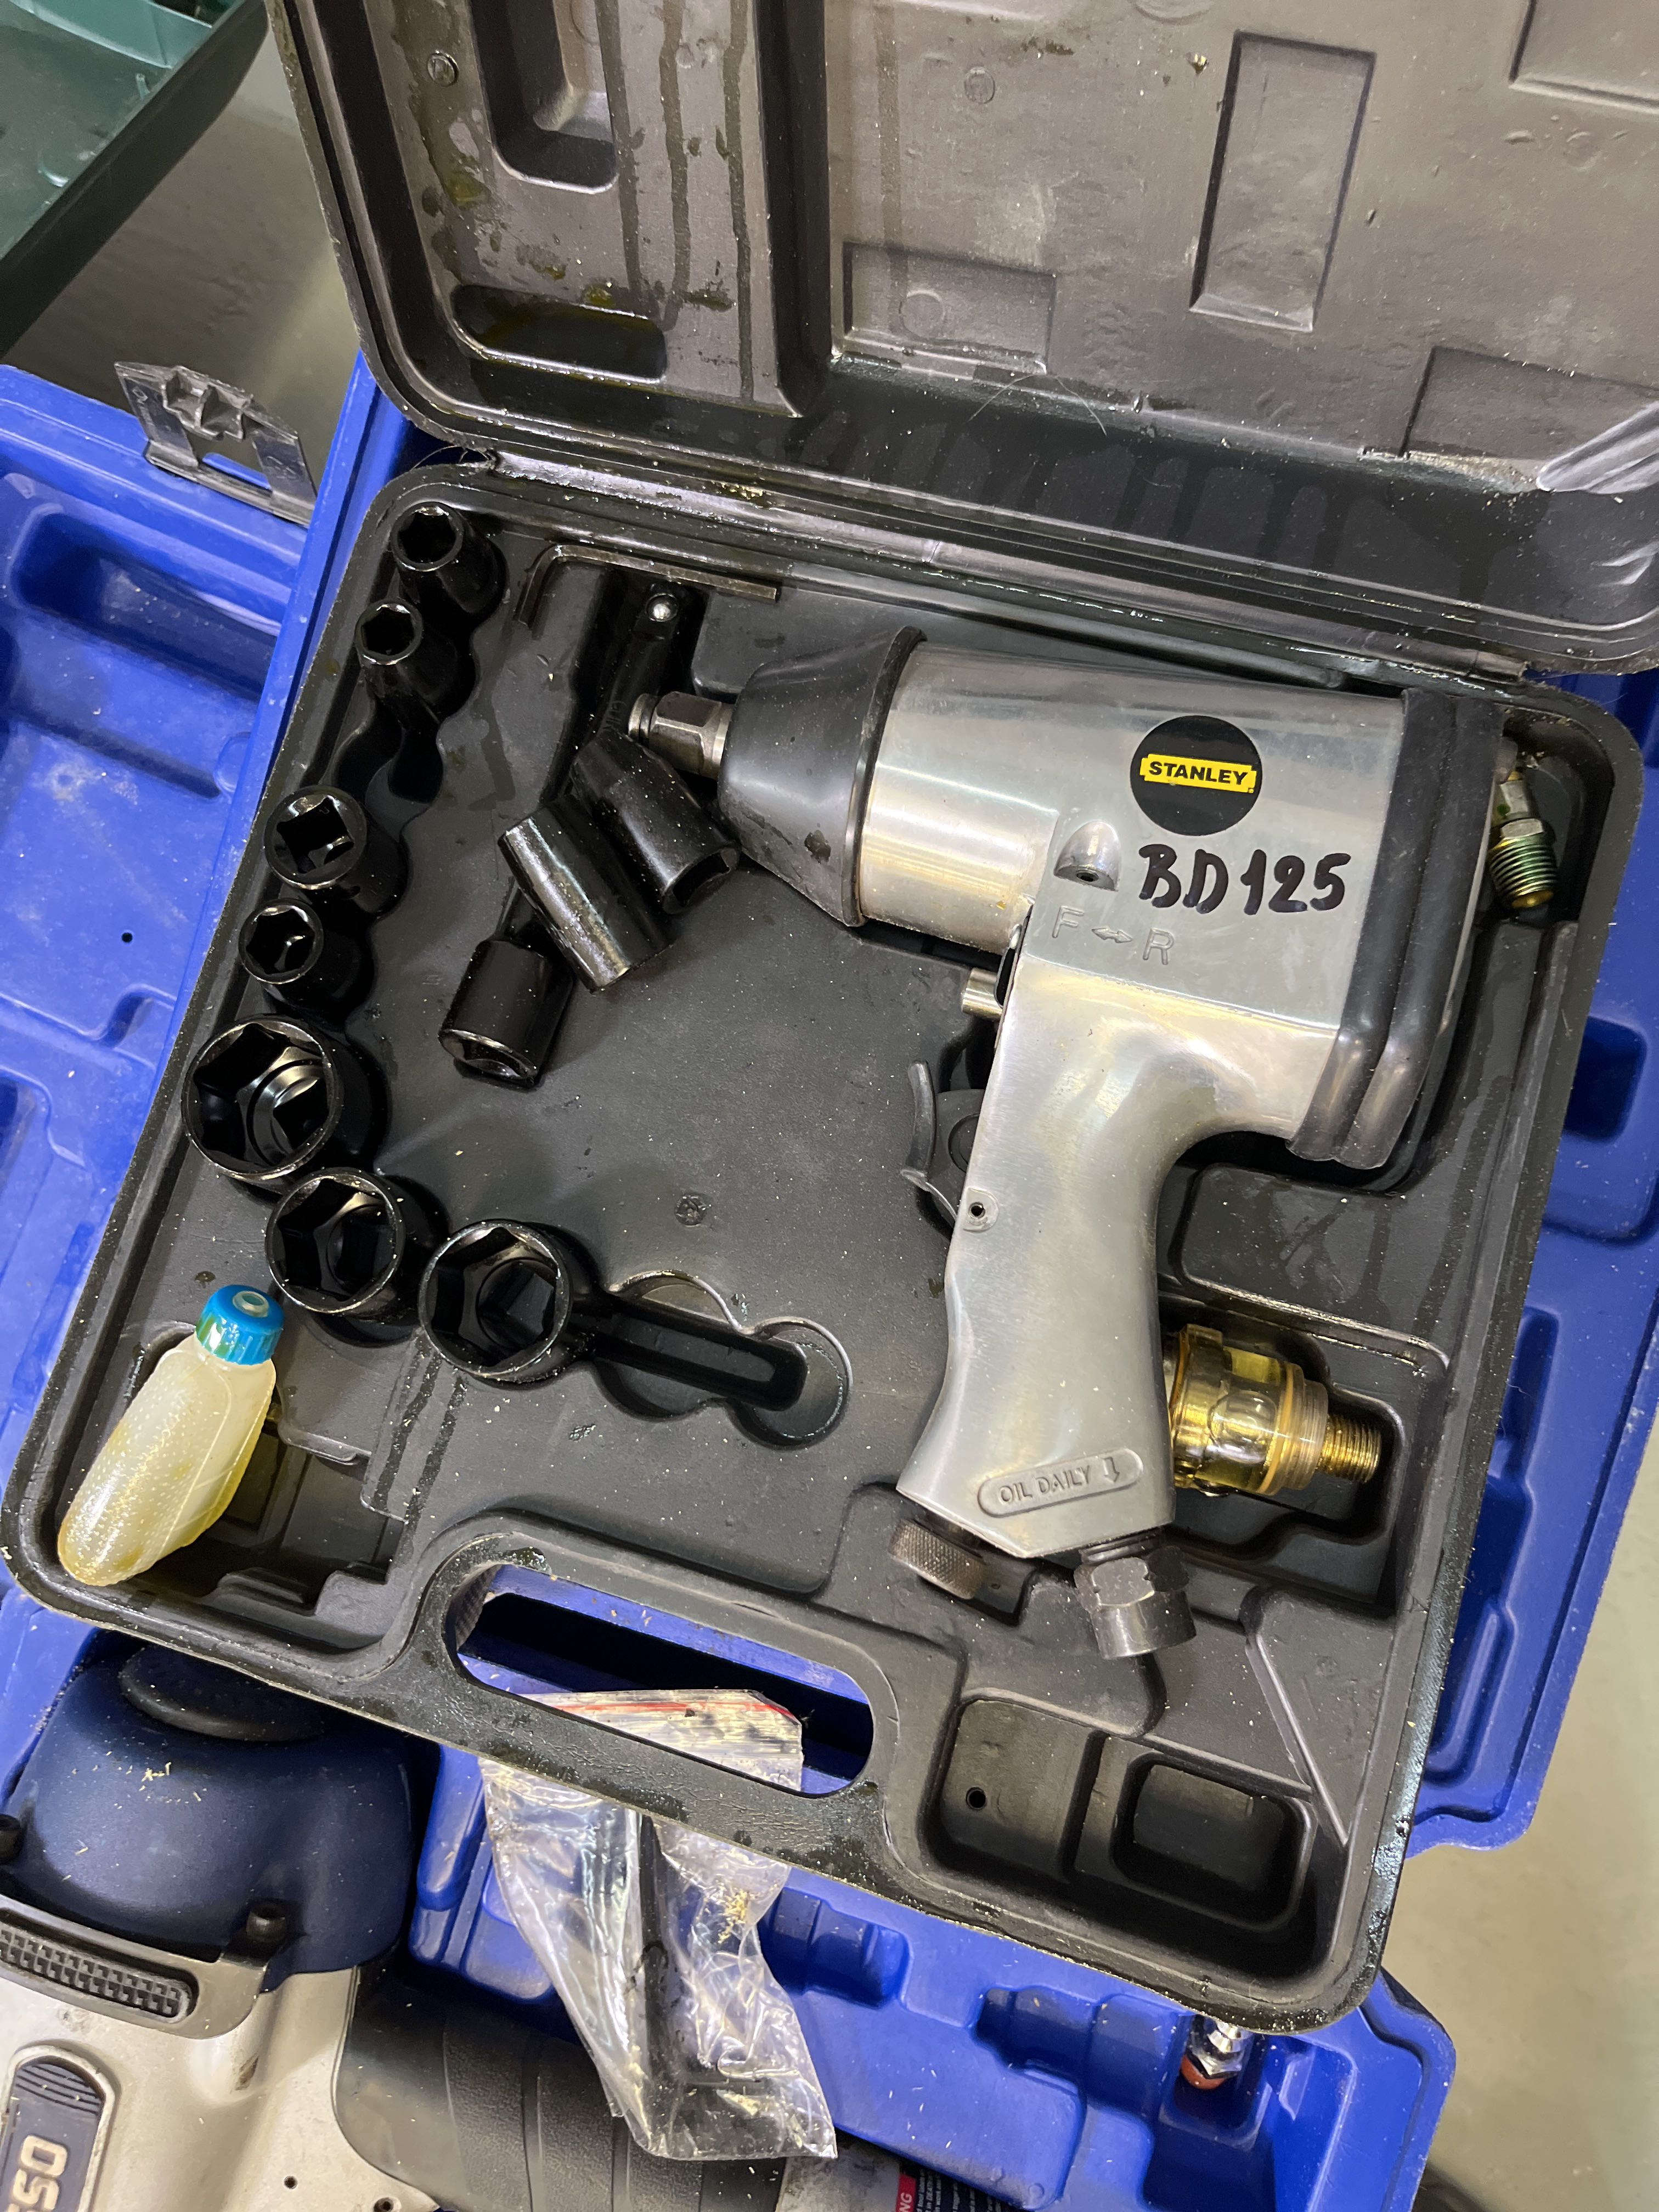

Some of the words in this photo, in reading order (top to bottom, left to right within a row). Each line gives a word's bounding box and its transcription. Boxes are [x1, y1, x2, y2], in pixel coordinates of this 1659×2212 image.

[1149, 761, 1248, 785] STANLEY
[1052, 905, 1085, 939] F
[1142, 927, 1175, 966] R
[998, 1481, 1033, 1504] OIL
[1034, 1464, 1090, 1494] DAILY
